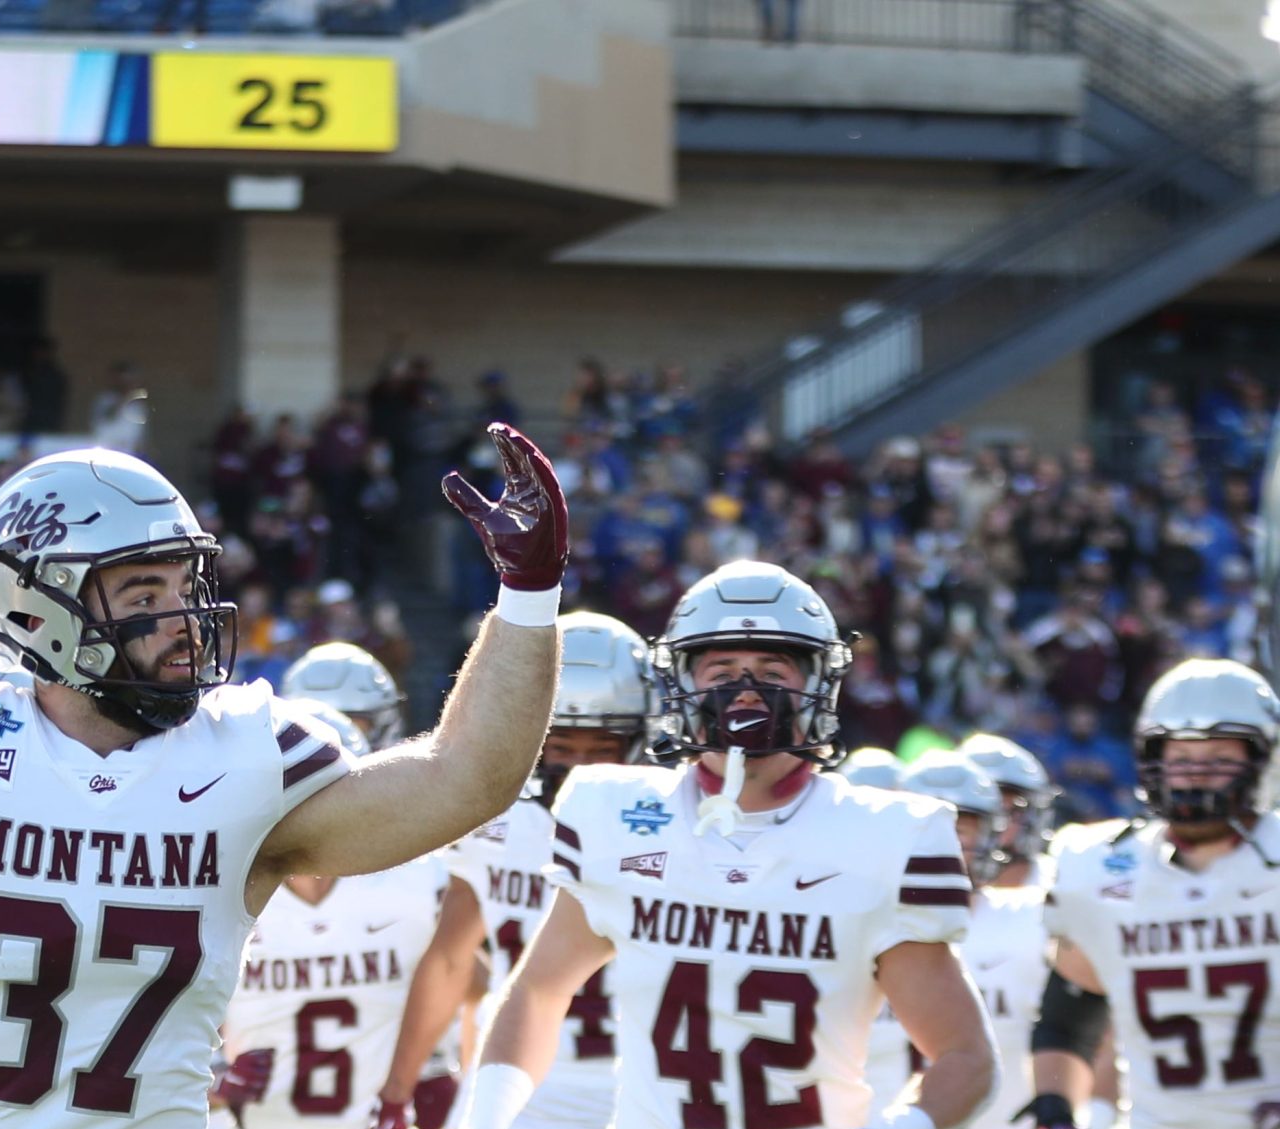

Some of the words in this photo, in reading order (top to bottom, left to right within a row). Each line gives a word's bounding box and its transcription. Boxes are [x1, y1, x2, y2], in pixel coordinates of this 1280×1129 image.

[235, 78, 328, 134] 25
[89, 774, 118, 794] Griz
[630, 896, 836, 960] MONTANA
[1118, 911, 1280, 957] MONTANA
[242, 950, 404, 992] MONTANA
[1133, 960, 1269, 1089] 57
[290, 997, 358, 1117] 6
